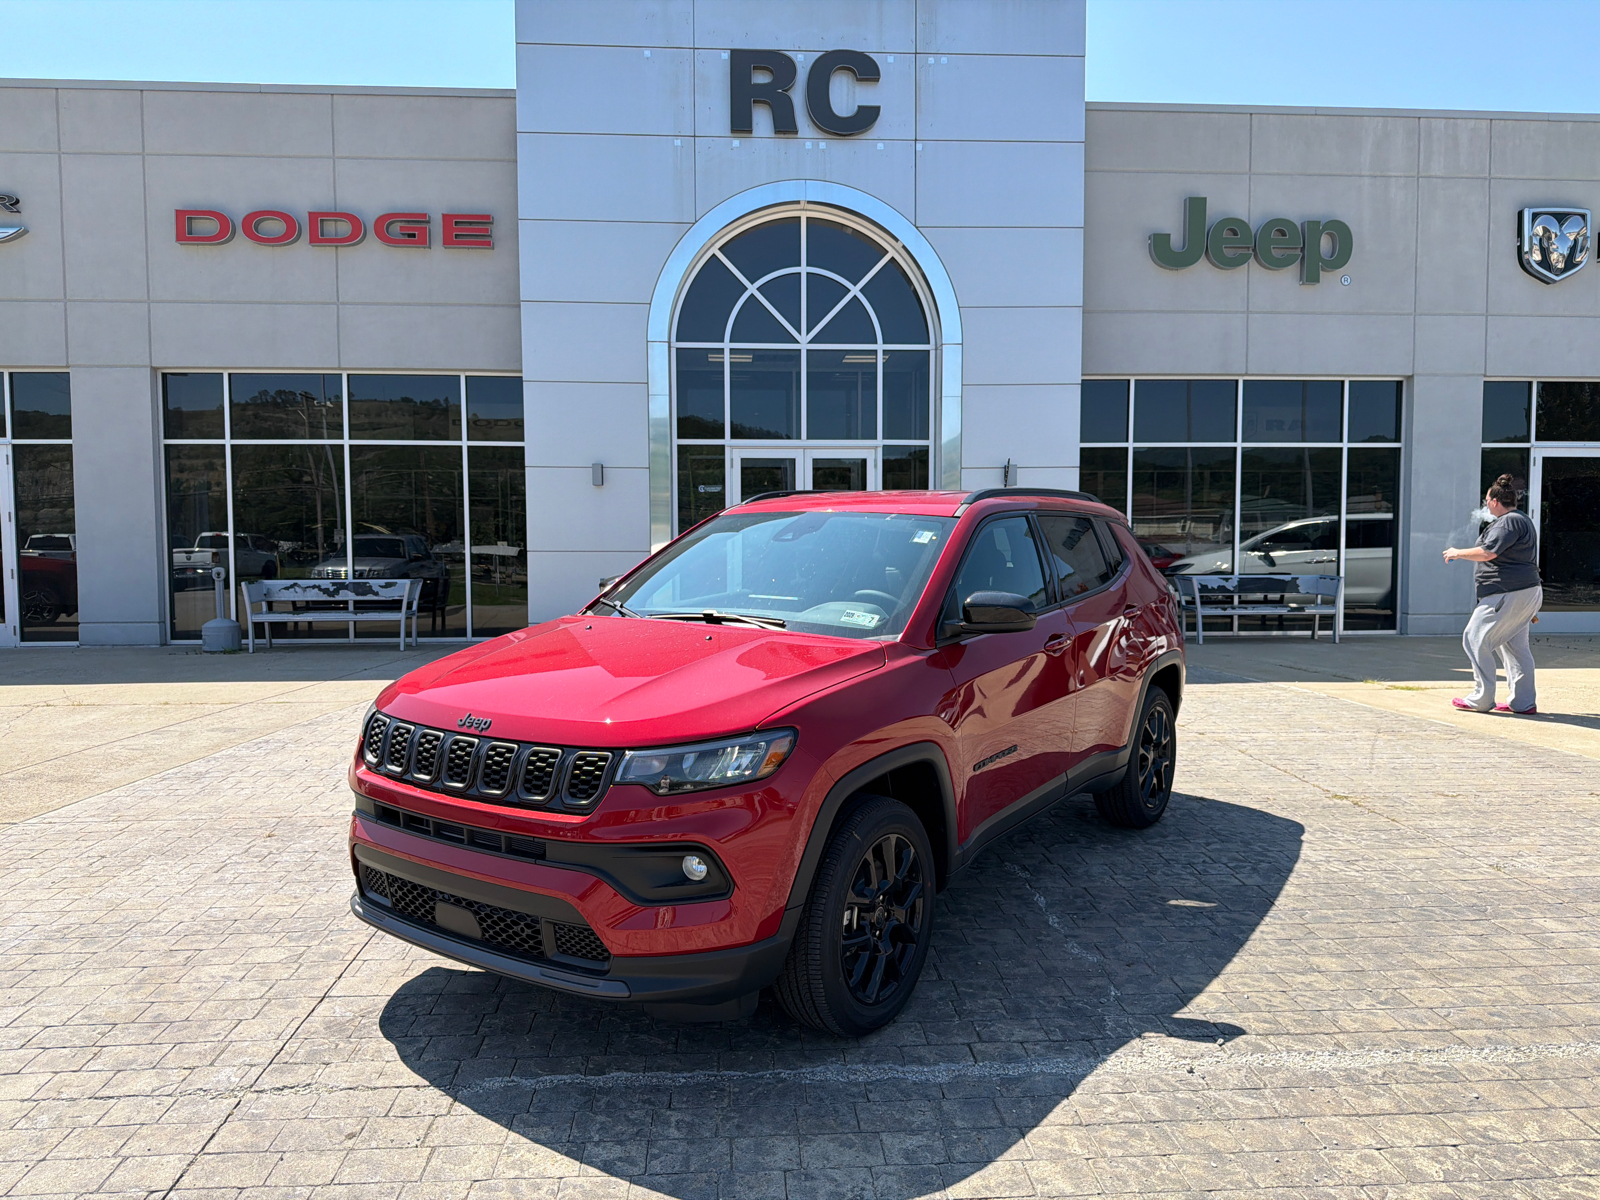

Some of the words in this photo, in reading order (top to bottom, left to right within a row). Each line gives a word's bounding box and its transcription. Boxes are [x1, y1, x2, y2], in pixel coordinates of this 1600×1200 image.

[730, 49, 881, 137] RC
[174, 208, 494, 249] DODGE
[1148, 196, 1354, 286] Jeep
[457, 712, 493, 734] Jeep
